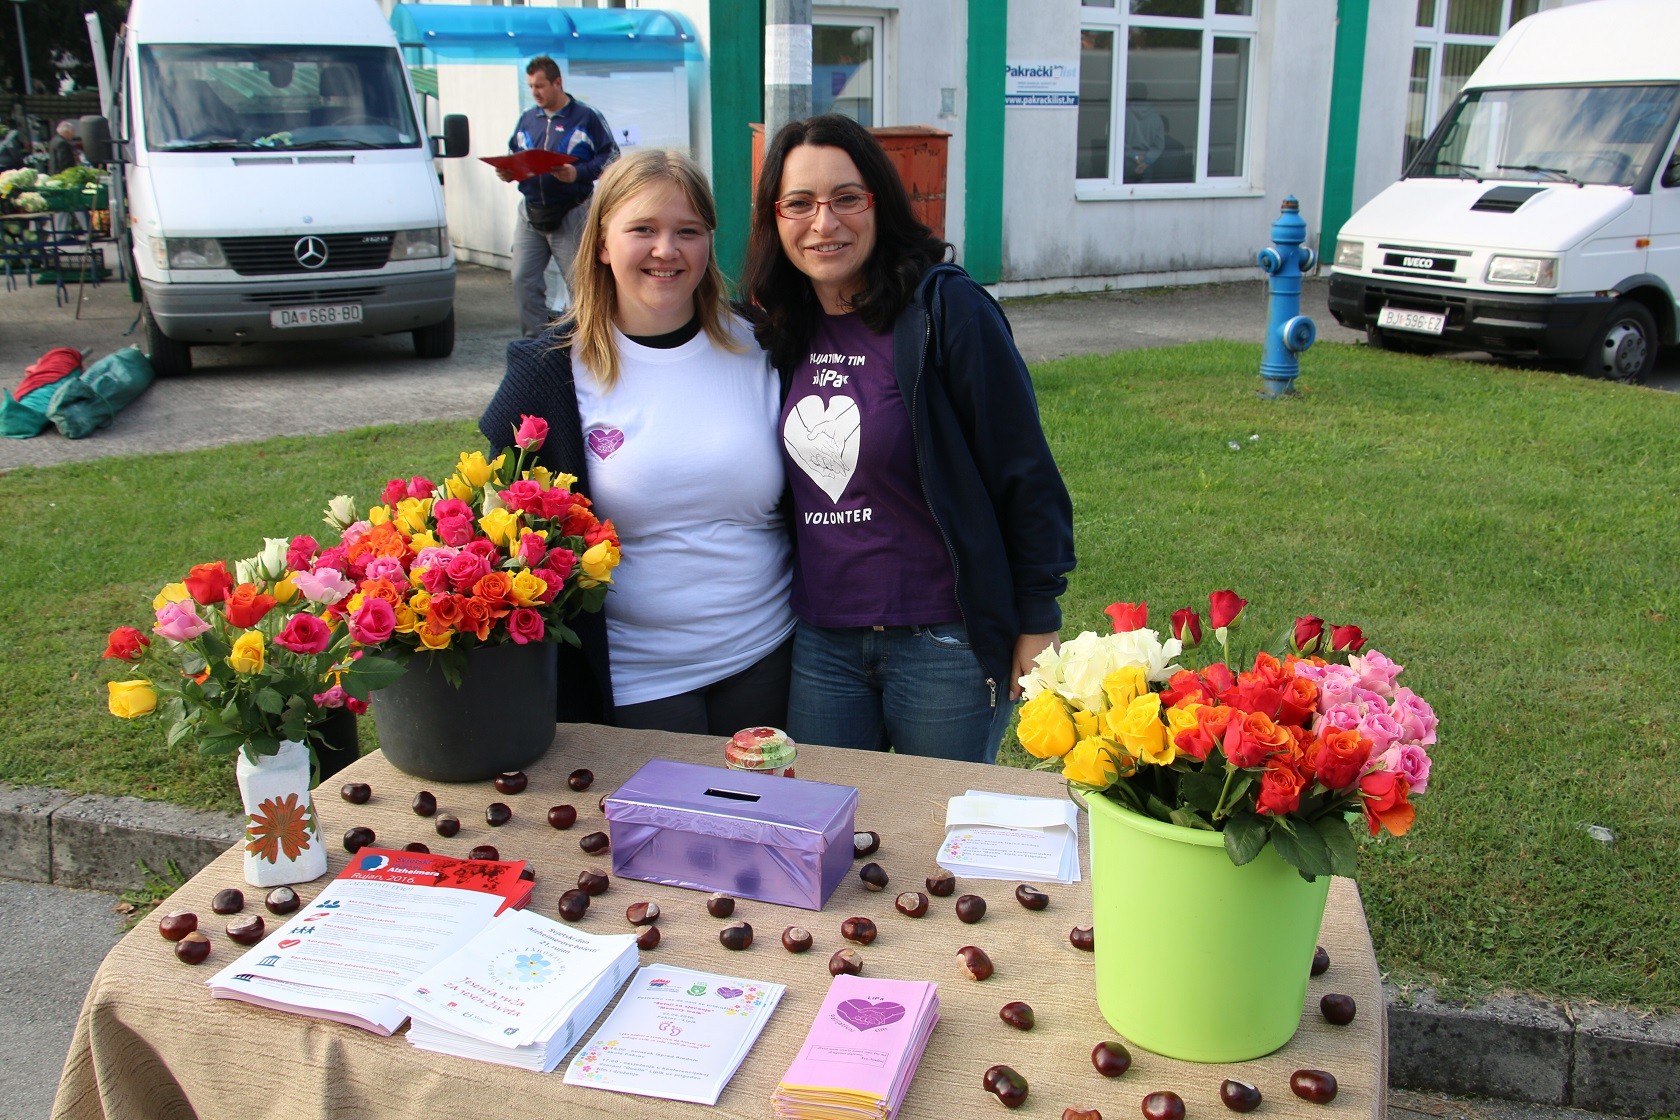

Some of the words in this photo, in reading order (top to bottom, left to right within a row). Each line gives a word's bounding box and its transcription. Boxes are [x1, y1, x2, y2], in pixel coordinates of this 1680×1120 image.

[1005, 65, 1053, 77] Pakrački
[1402, 256, 1433, 268] IVECO
[848, 355, 866, 366] TIM
[804, 508, 872, 525] VOLONTER
[387, 866, 440, 877] Alzheimera
[386, 874, 416, 884] 2016.
[548, 928, 576, 940] Svjetski
